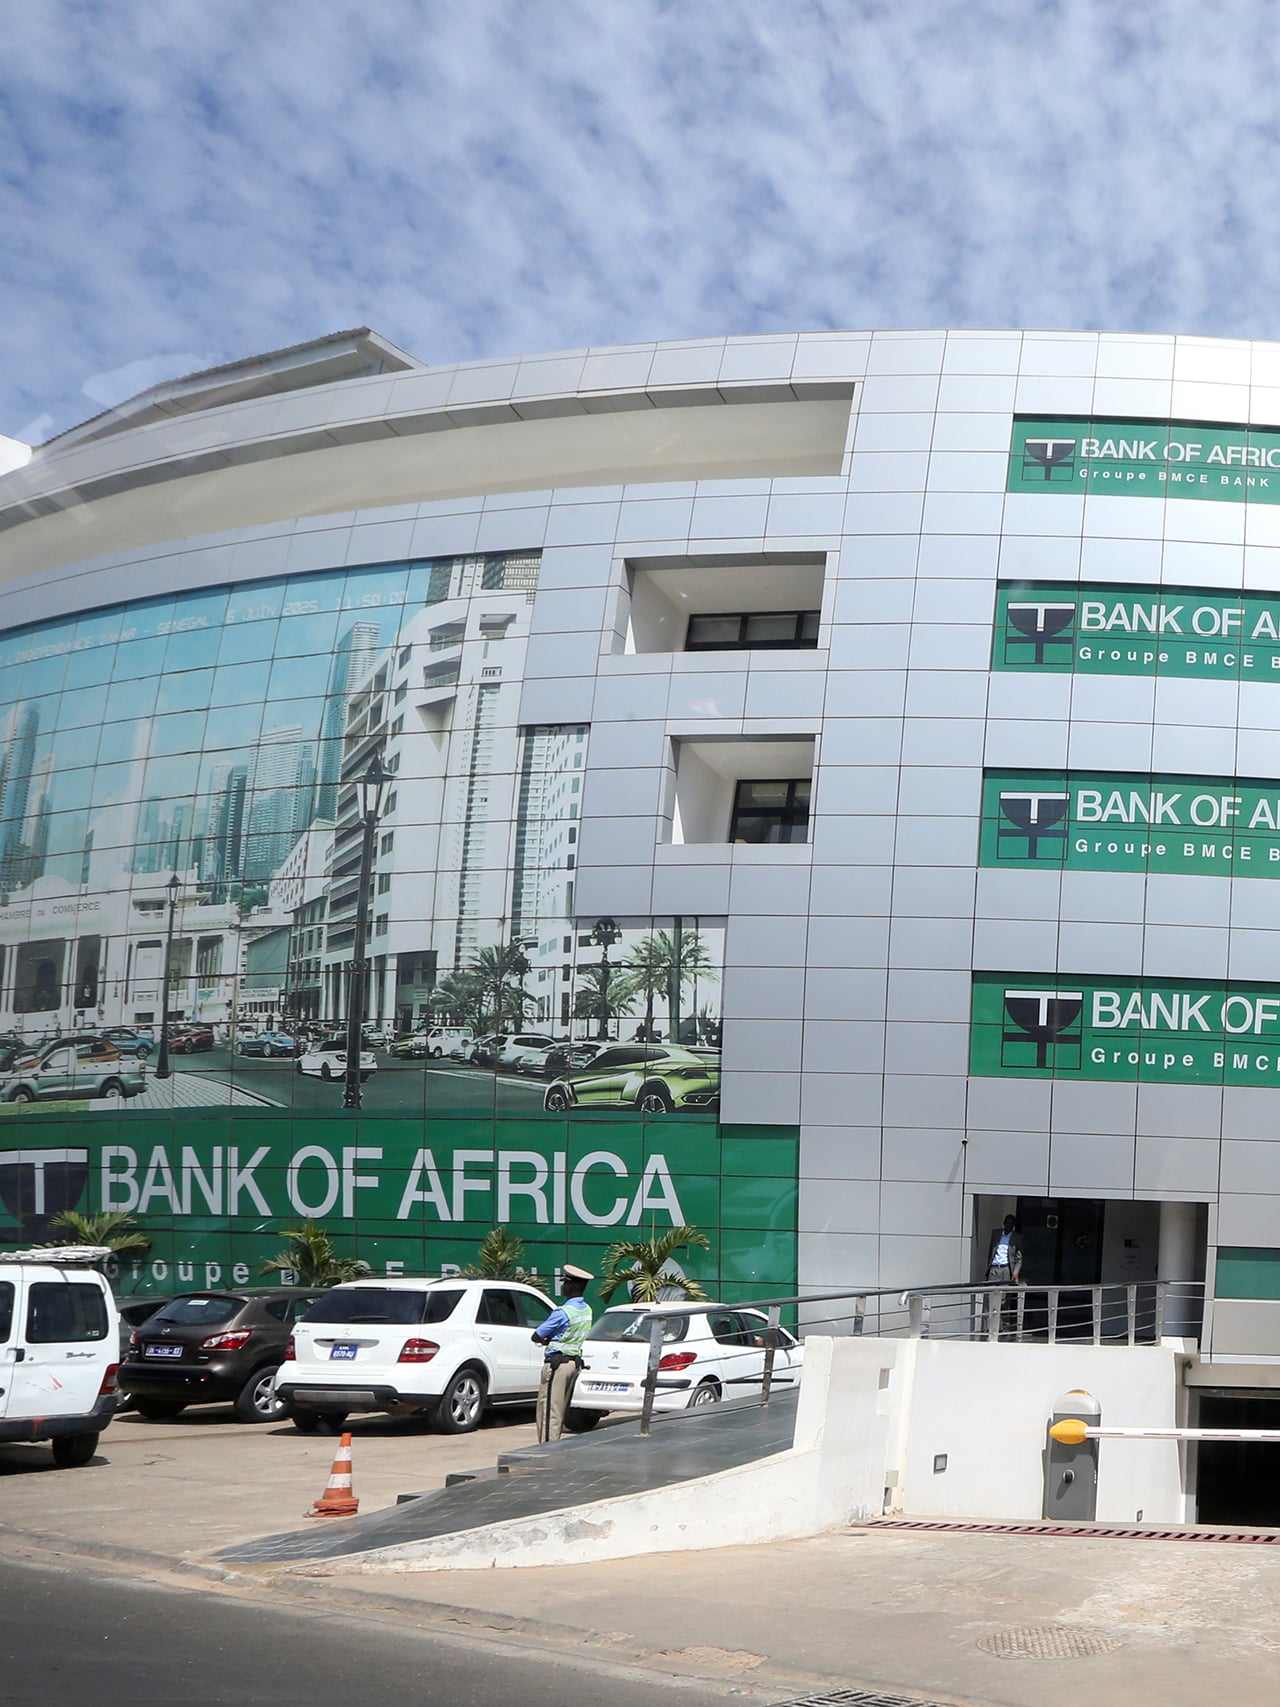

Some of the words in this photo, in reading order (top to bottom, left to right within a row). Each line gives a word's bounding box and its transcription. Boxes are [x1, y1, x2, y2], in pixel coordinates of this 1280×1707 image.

[1080, 438, 1159, 460] BANK
[1163, 442, 1202, 462] OF
[1079, 469, 1146, 481] Groupe
[1158, 472, 1208, 484] BMCE
[1220, 475, 1269, 488] BANK
[1081, 601, 1185, 635] BANK
[1191, 606, 1245, 637] OF
[1079, 647, 1169, 664] Groupe
[1185, 651, 1254, 668] BMCE
[1076, 790, 1182, 825] BANK
[1190, 794, 1242, 827] OF
[1075, 839, 1167, 857] Groupe
[1183, 843, 1251, 860] BMCE
[1091, 990, 1212, 1032] BANK
[1220, 995, 1280, 1034] OF
[1091, 1047, 1194, 1069] Groupe
[101, 1145, 273, 1216] BANK
[286, 1145, 383, 1219] OF
[396, 1148, 686, 1228] AFRICA
[103, 1252, 249, 1290] Groupe
